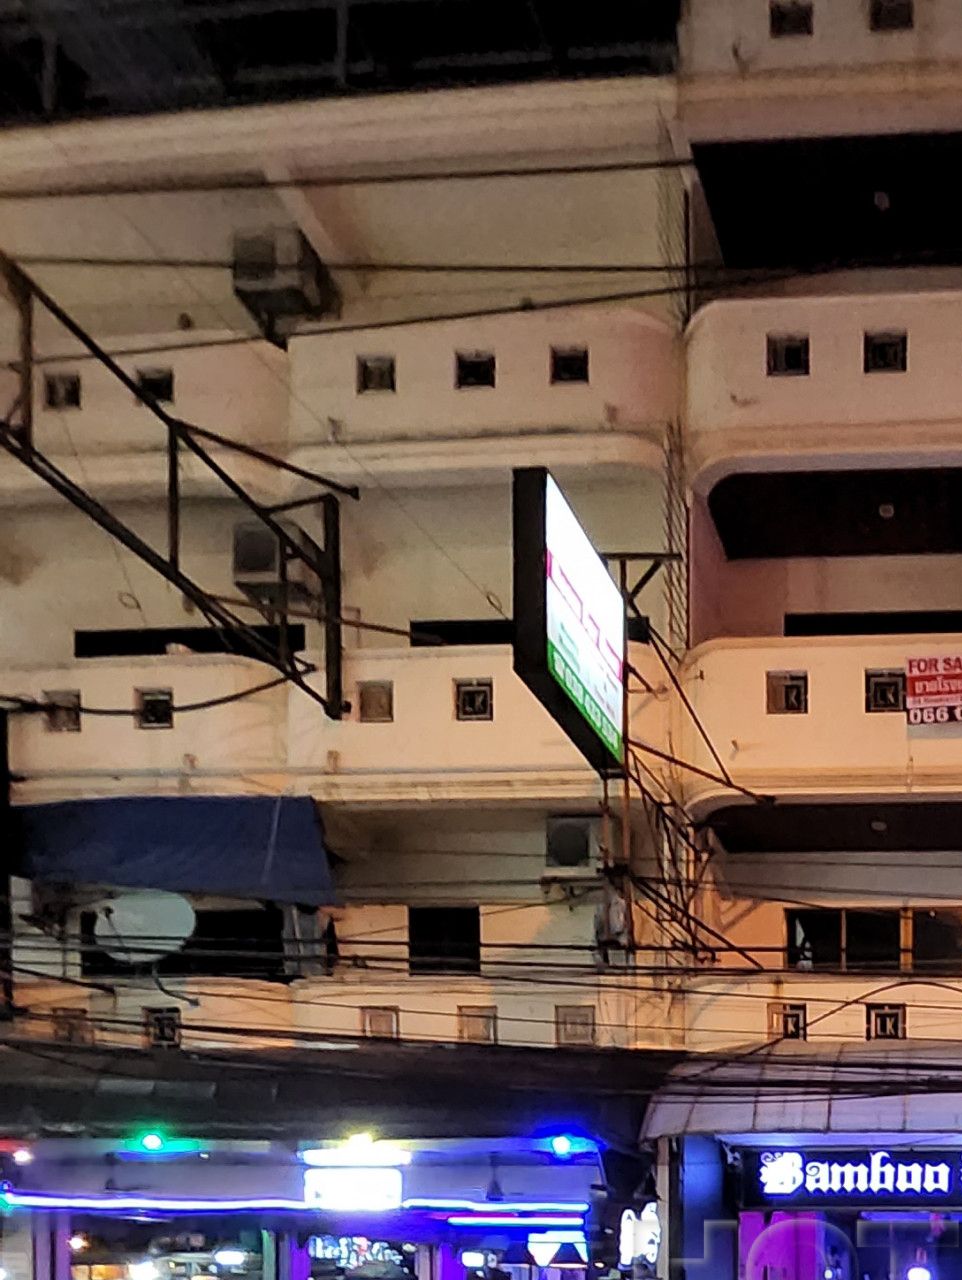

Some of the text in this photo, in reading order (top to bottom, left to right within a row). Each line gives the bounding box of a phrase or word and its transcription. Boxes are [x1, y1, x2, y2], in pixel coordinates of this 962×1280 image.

[909, 658, 939, 674] FOR
[909, 707, 949, 724] 066
[759, 1151, 951, 1195] Bamboo
